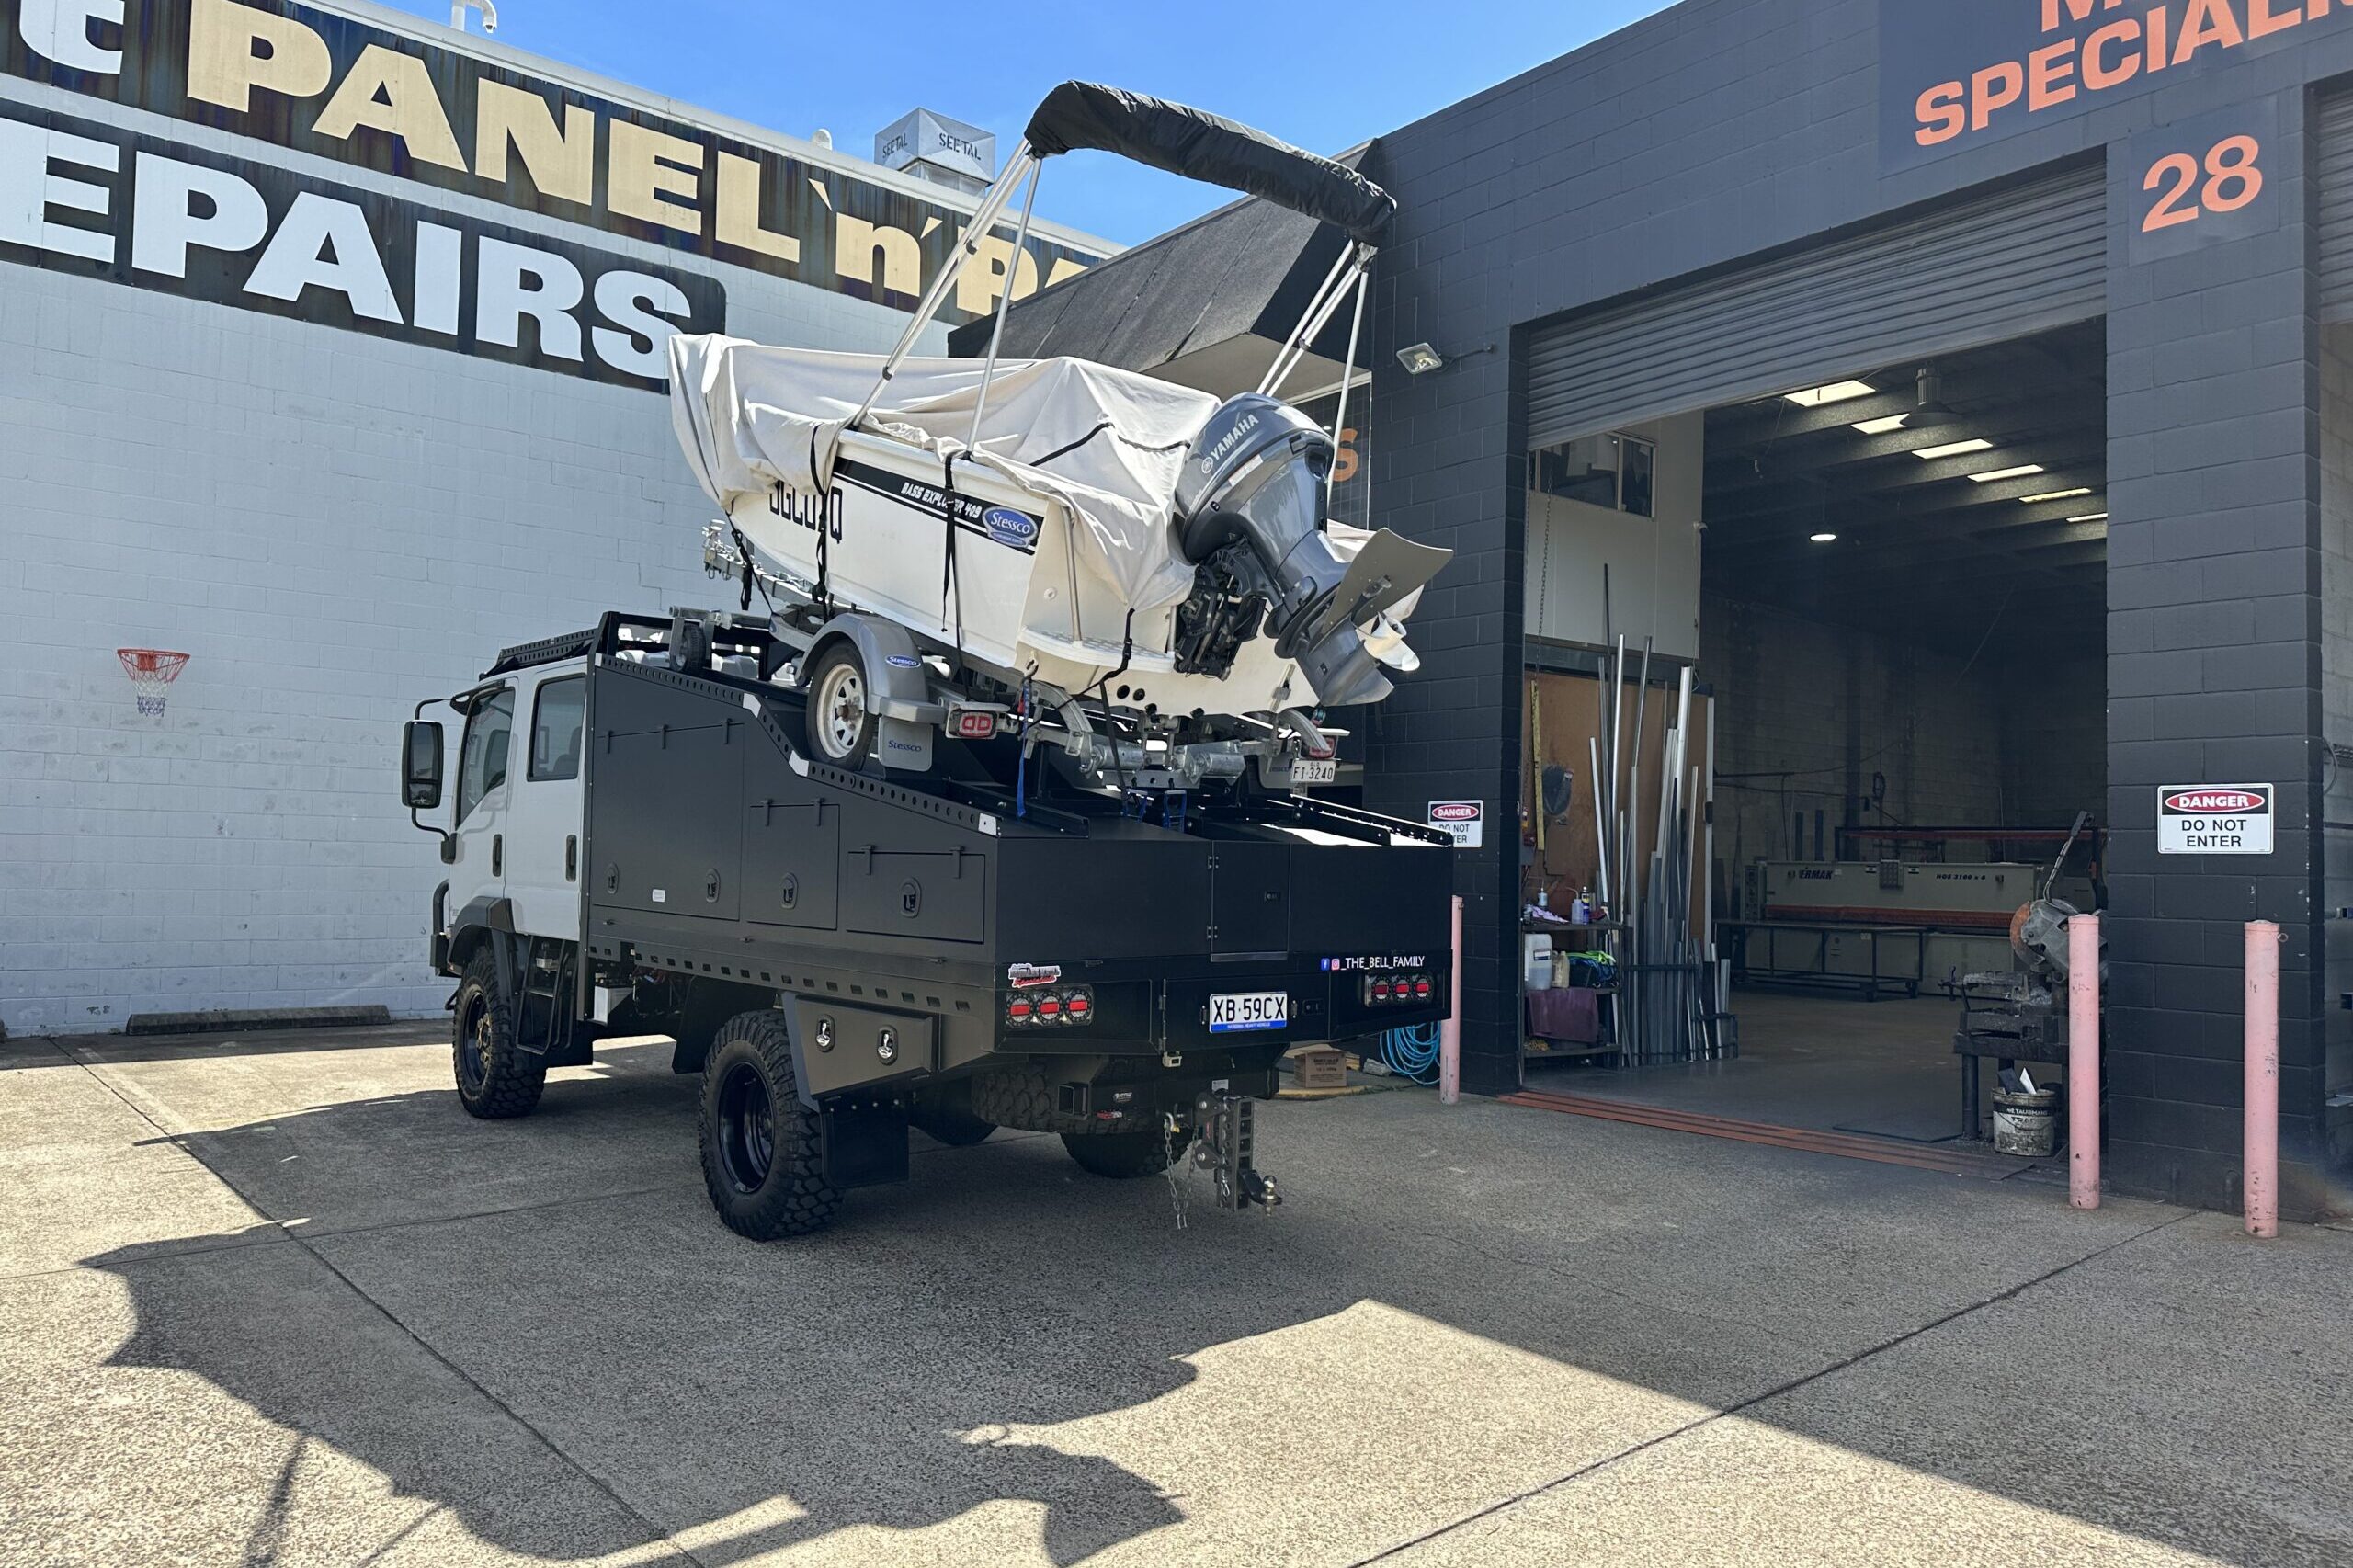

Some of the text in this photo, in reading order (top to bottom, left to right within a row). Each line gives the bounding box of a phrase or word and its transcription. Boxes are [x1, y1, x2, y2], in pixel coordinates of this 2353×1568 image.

[187, 0, 800, 263] PANEL
[2142, 135, 2263, 233] 28
[1211, 414, 1259, 460] YAMAHA
[964, 502, 983, 519] 409
[991, 512, 1030, 535] Stessco
[889, 656, 917, 665] Stessco
[888, 740, 922, 752] Stessco
[2178, 795, 2249, 808] DANGER
[1438, 808, 1472, 816] DANGER
[1453, 824, 1470, 833] NOT
[2181, 819, 2247, 831] DO NOT
[2187, 835, 2242, 847] ENTER
